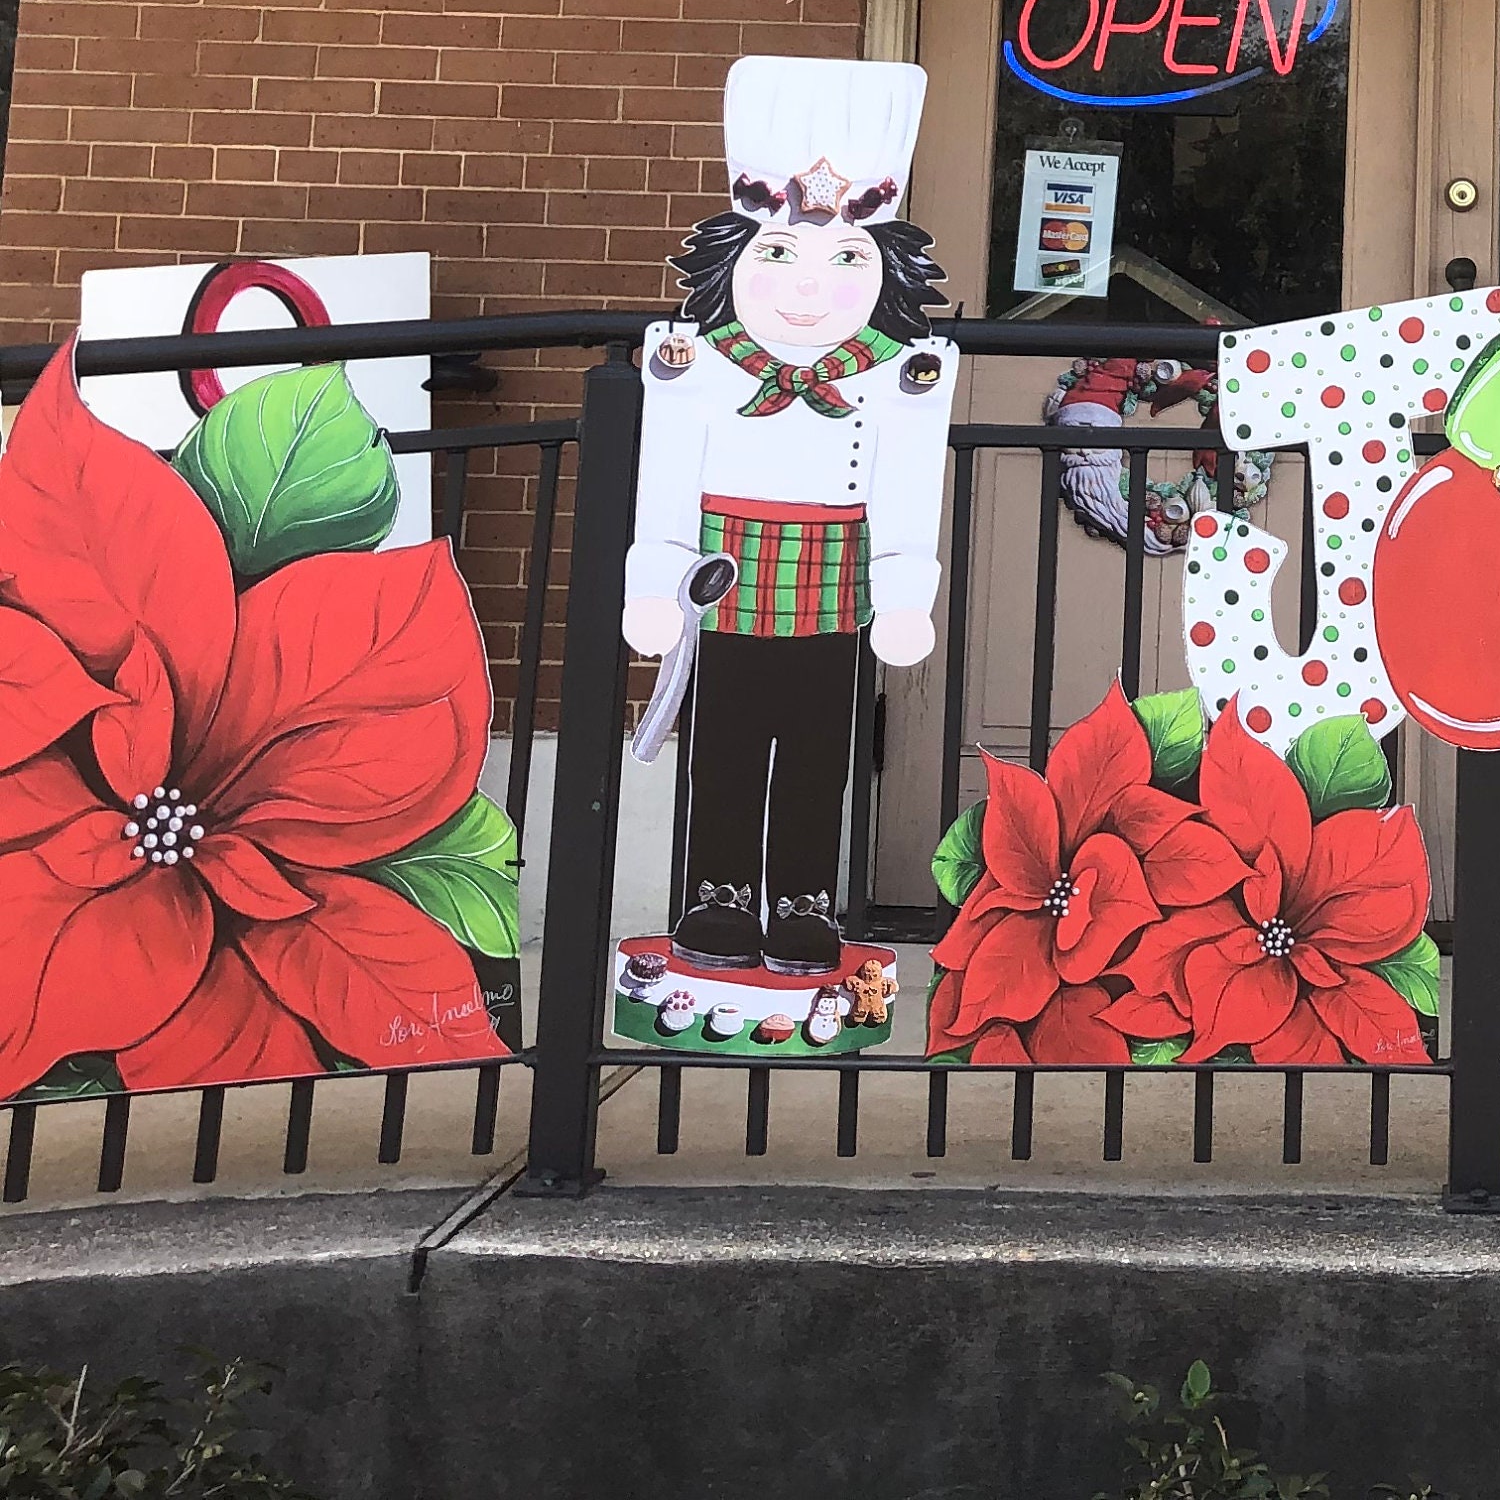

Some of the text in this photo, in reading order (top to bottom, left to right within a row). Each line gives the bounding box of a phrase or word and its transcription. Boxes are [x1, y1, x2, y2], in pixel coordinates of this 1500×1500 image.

[1039, 154, 1107, 176] We Accept
[1053, 191, 1085, 205] VISA
